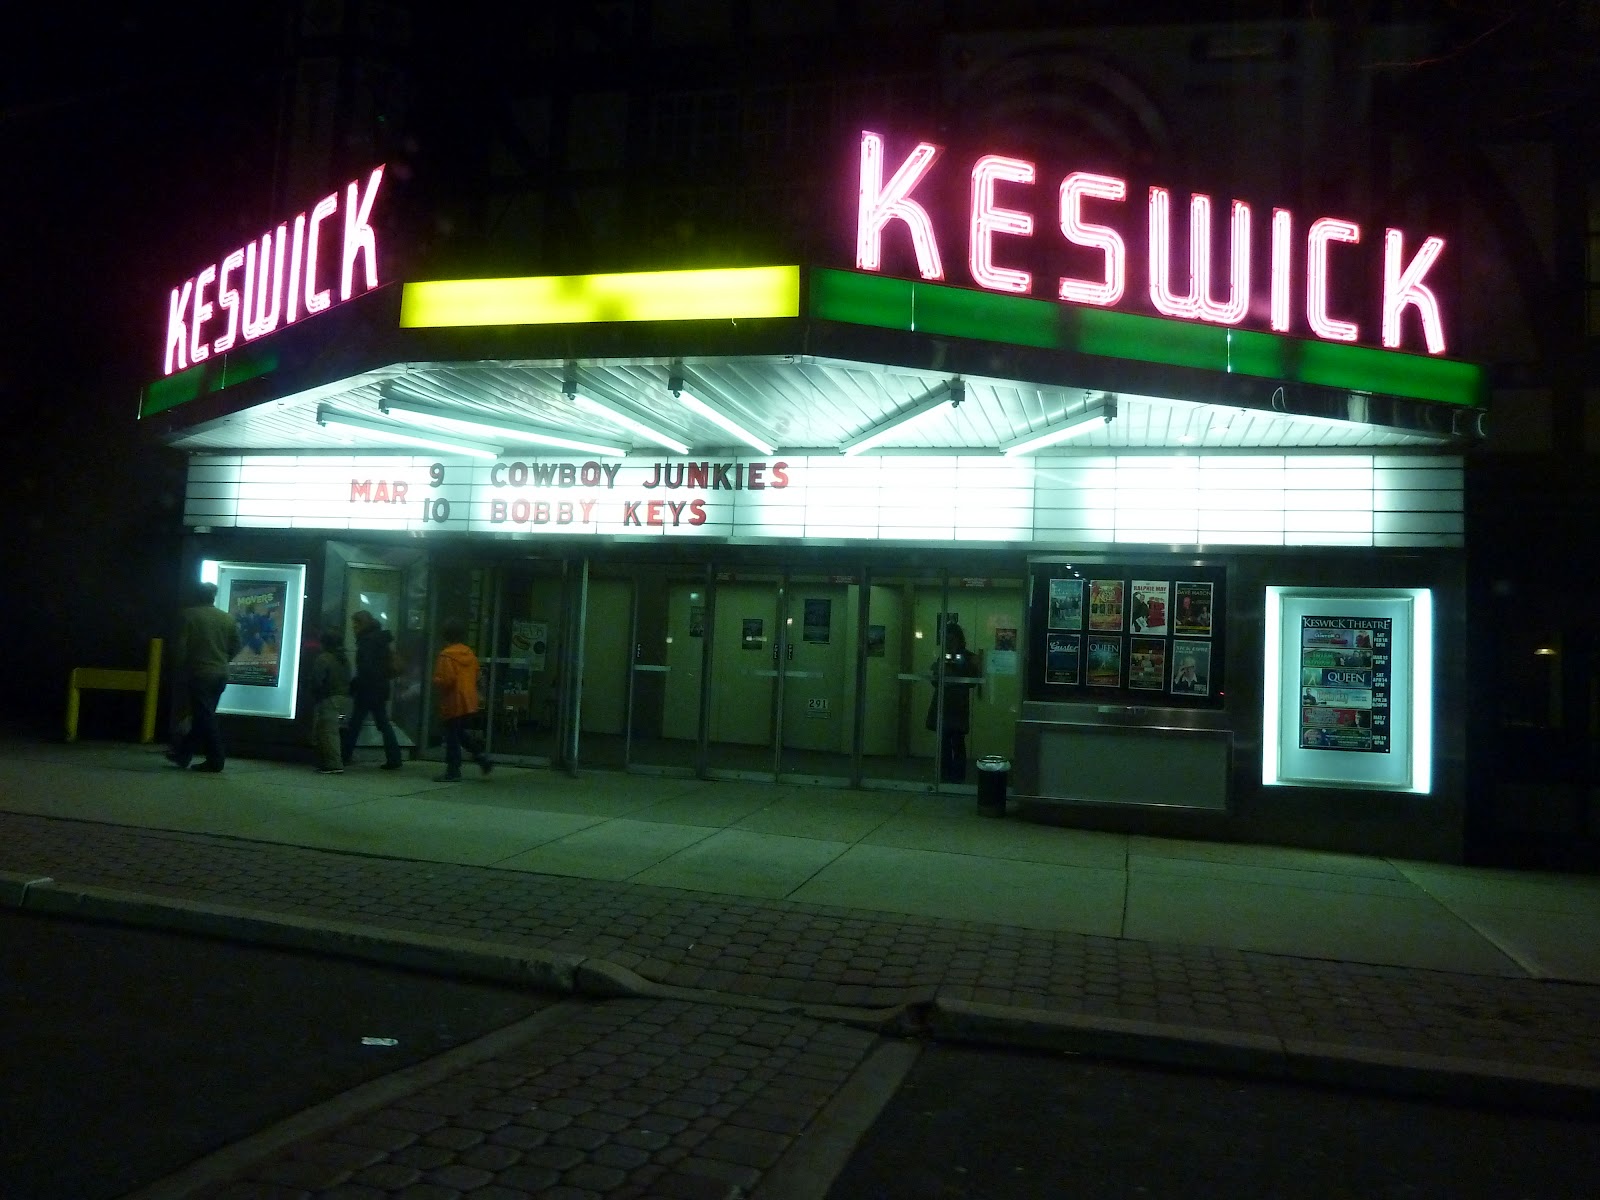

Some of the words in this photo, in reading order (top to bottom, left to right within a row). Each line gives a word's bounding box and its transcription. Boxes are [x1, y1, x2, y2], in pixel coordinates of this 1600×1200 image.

[855, 130, 1447, 356] KESWICK
[164, 163, 386, 375] KESWICK
[429, 462, 445, 488] 9
[490, 461, 621, 489] COWBOY
[642, 461, 789, 491] JUNKIES
[349, 478, 409, 505] MAR
[423, 497, 450, 523] 10
[490, 498, 597, 525] BOBBY
[623, 498, 707, 526] KEYS
[1304, 617, 1346, 629] KESWICK
[1346, 619, 1390, 630] THEATRE
[1089, 643, 1119, 653] QUEEN
[1327, 671, 1365, 684] QUEEN
[809, 699, 827, 709] 291
